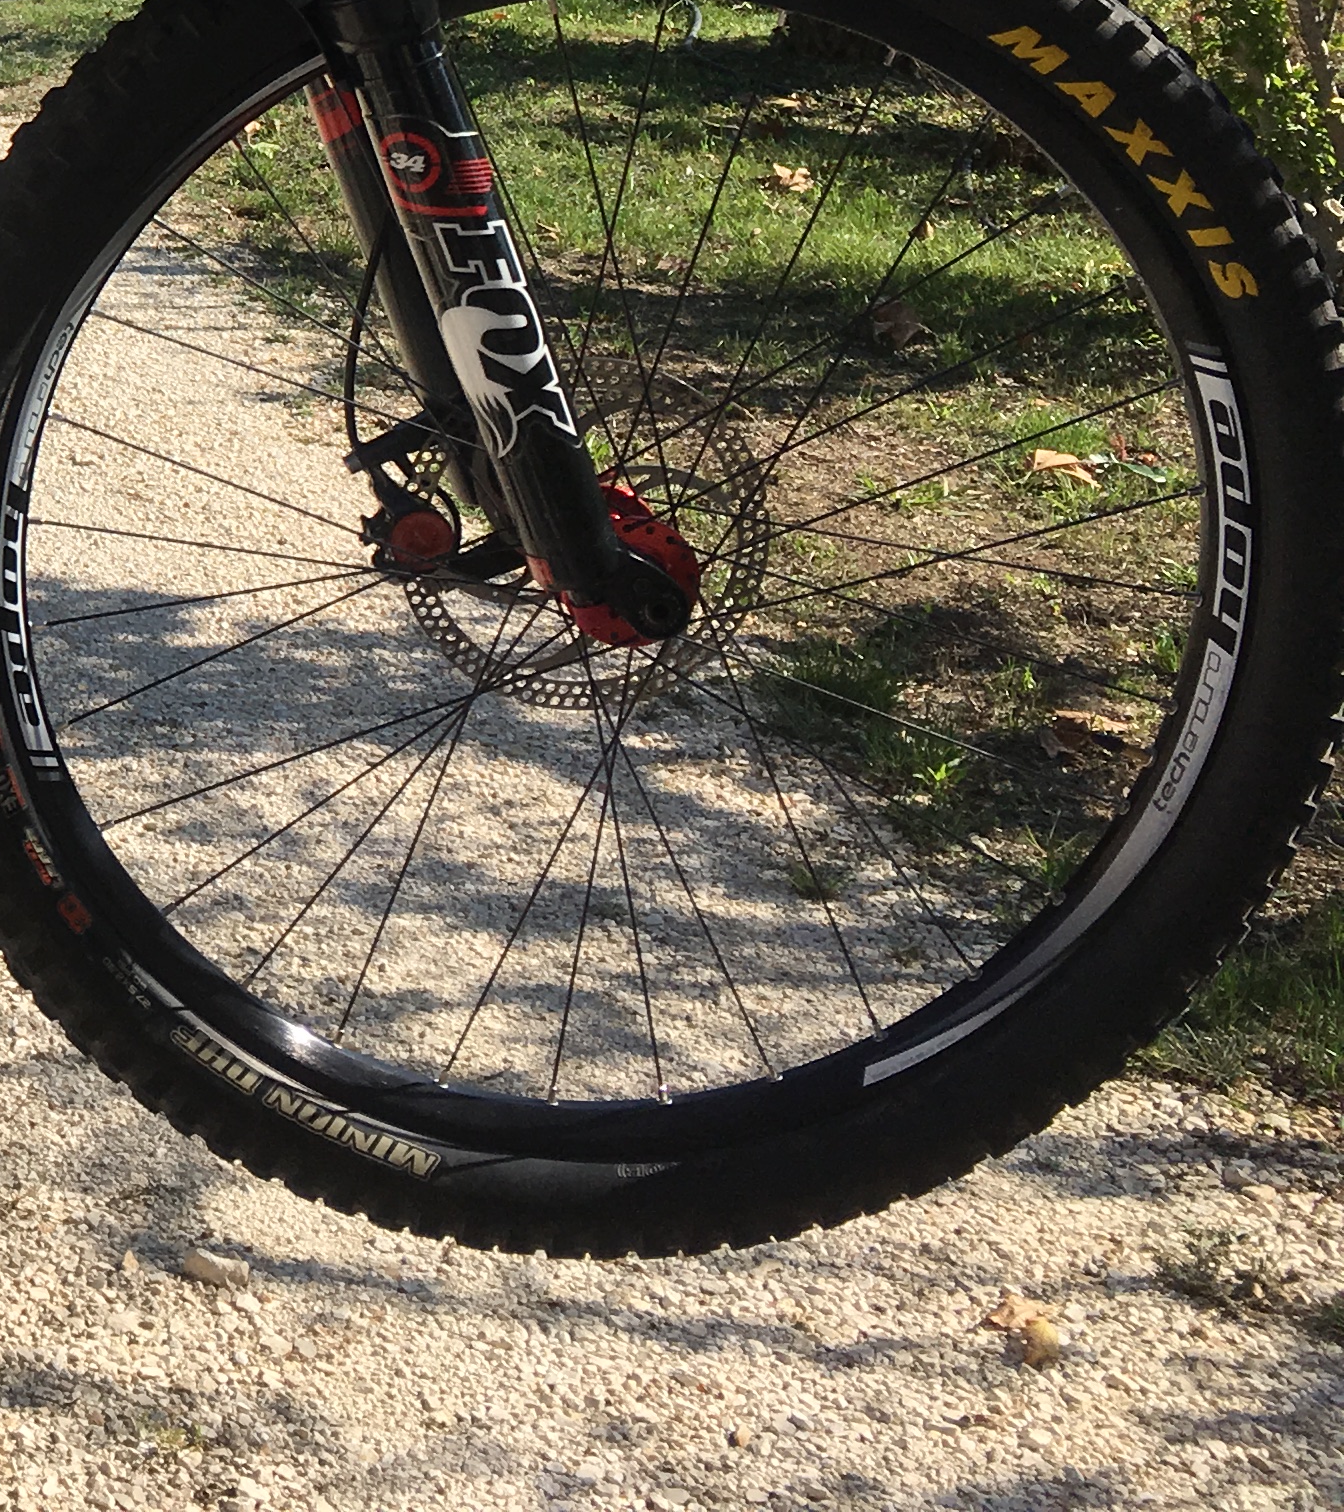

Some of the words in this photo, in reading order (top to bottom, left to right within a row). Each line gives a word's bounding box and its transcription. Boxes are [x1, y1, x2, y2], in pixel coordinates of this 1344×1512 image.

[389, 151, 427, 173] 34
[987, 25, 1259, 300] MAXXIS
[433, 219, 578, 438] FOX
[1210, 399, 1252, 656] hope
[170, 1025, 264, 1096] DHF
[262, 1082, 442, 1182] MINION
